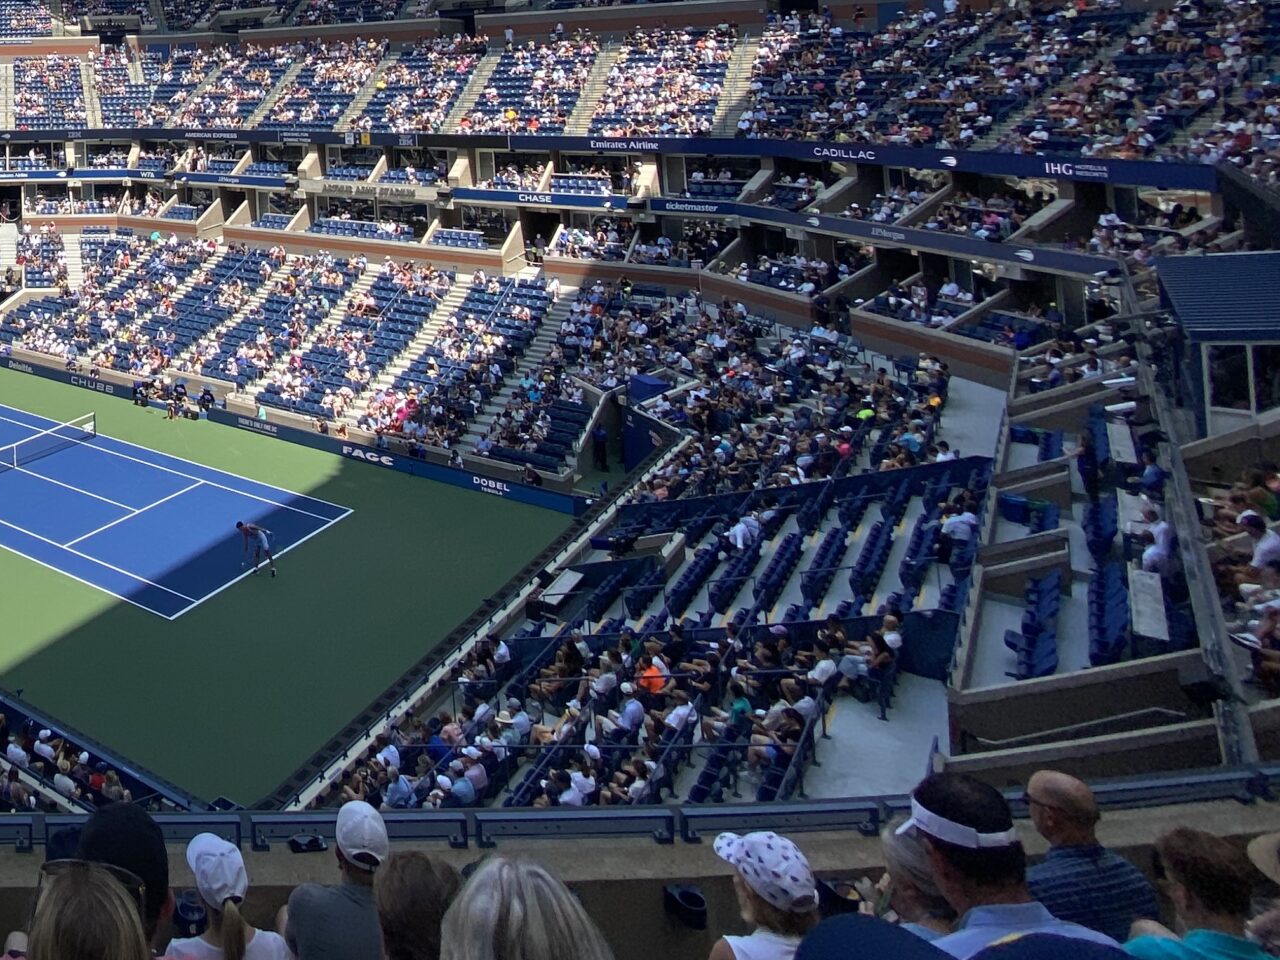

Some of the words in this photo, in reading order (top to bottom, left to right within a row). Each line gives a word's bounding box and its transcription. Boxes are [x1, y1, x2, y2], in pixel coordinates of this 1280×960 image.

[589, 140, 627, 149] Emirates
[629, 140, 659, 150] Airline
[813, 147, 876, 160] CADILLAC
[1044, 162, 1073, 176] IHG
[518, 193, 552, 203] CHASE
[665, 201, 718, 213] ticketmaster
[8, 360, 34, 374] Deloitte.
[70, 376, 114, 393] CHUBB
[472, 476, 510, 492] DOBEL
